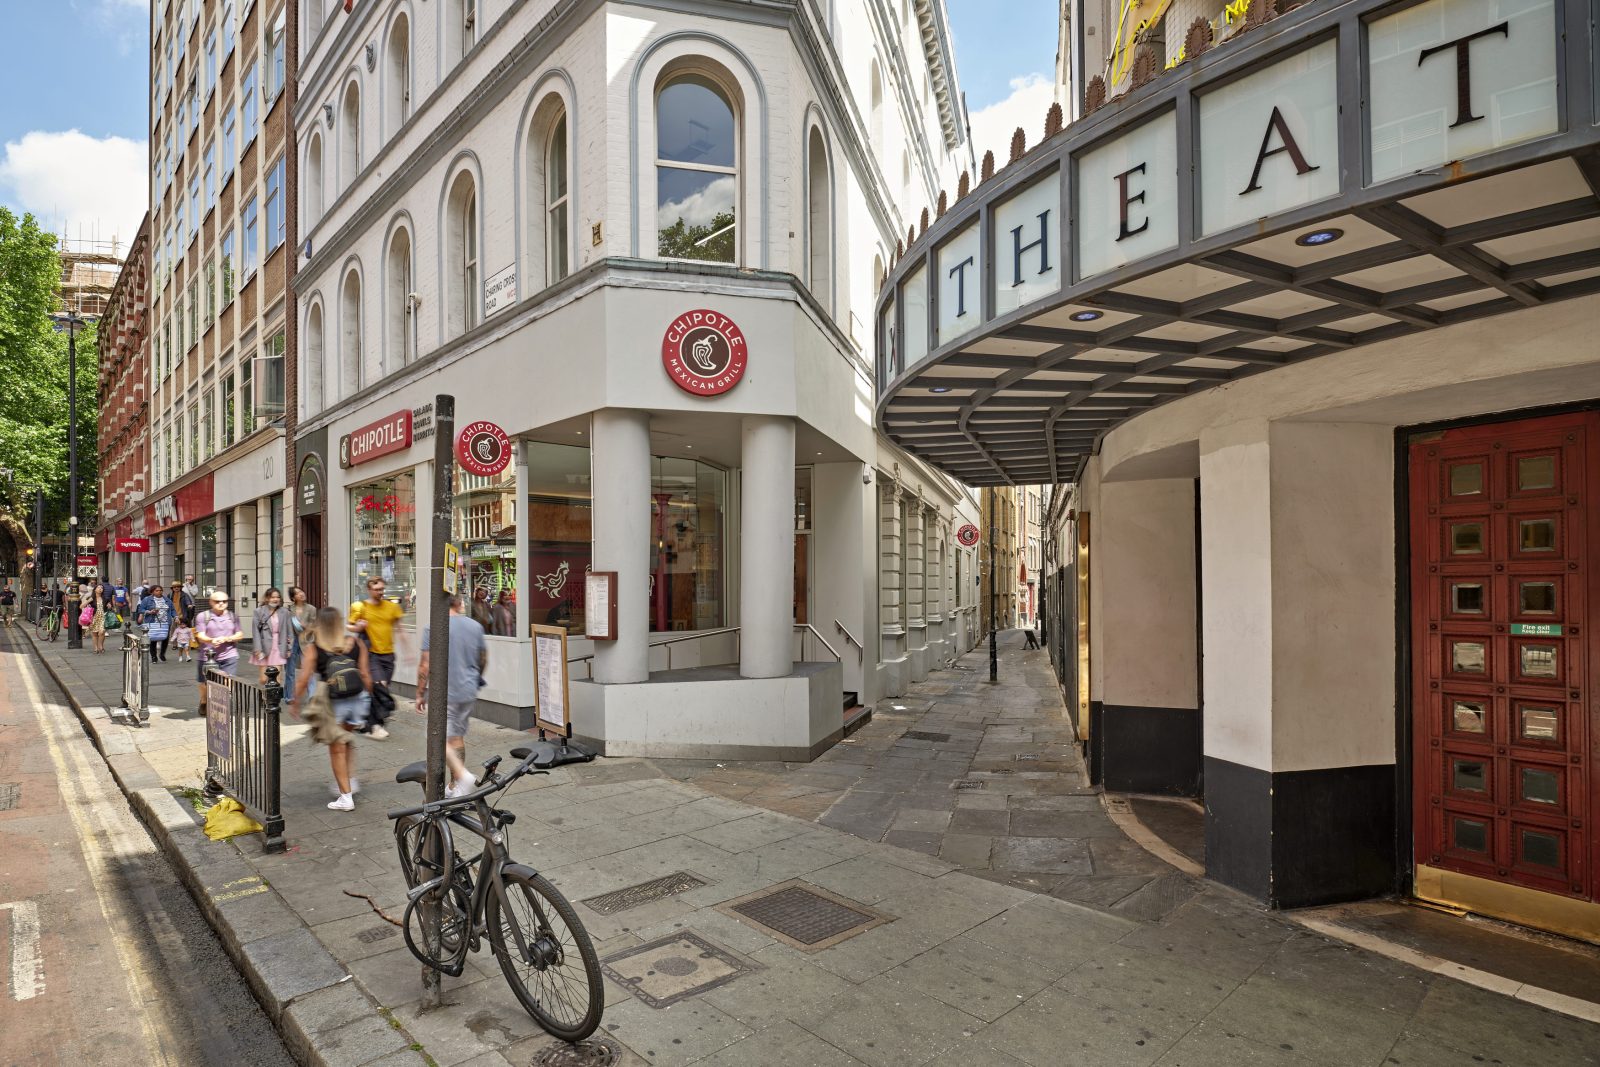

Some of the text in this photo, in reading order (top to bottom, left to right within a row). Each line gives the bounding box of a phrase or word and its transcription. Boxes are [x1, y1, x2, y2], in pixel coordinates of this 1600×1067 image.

[949, 22, 1509, 318] THEAT
[503, 273, 516, 288] CROS
[668, 313, 743, 347] CHIPOTLE
[670, 358, 742, 389] MEXICAN GRILL
[351, 418, 404, 457] CHIPOTLE
[462, 423, 509, 446] CHIPOTLE
[262, 456, 274, 481] 120
[463, 451, 509, 473] MEXICAN GRILL
